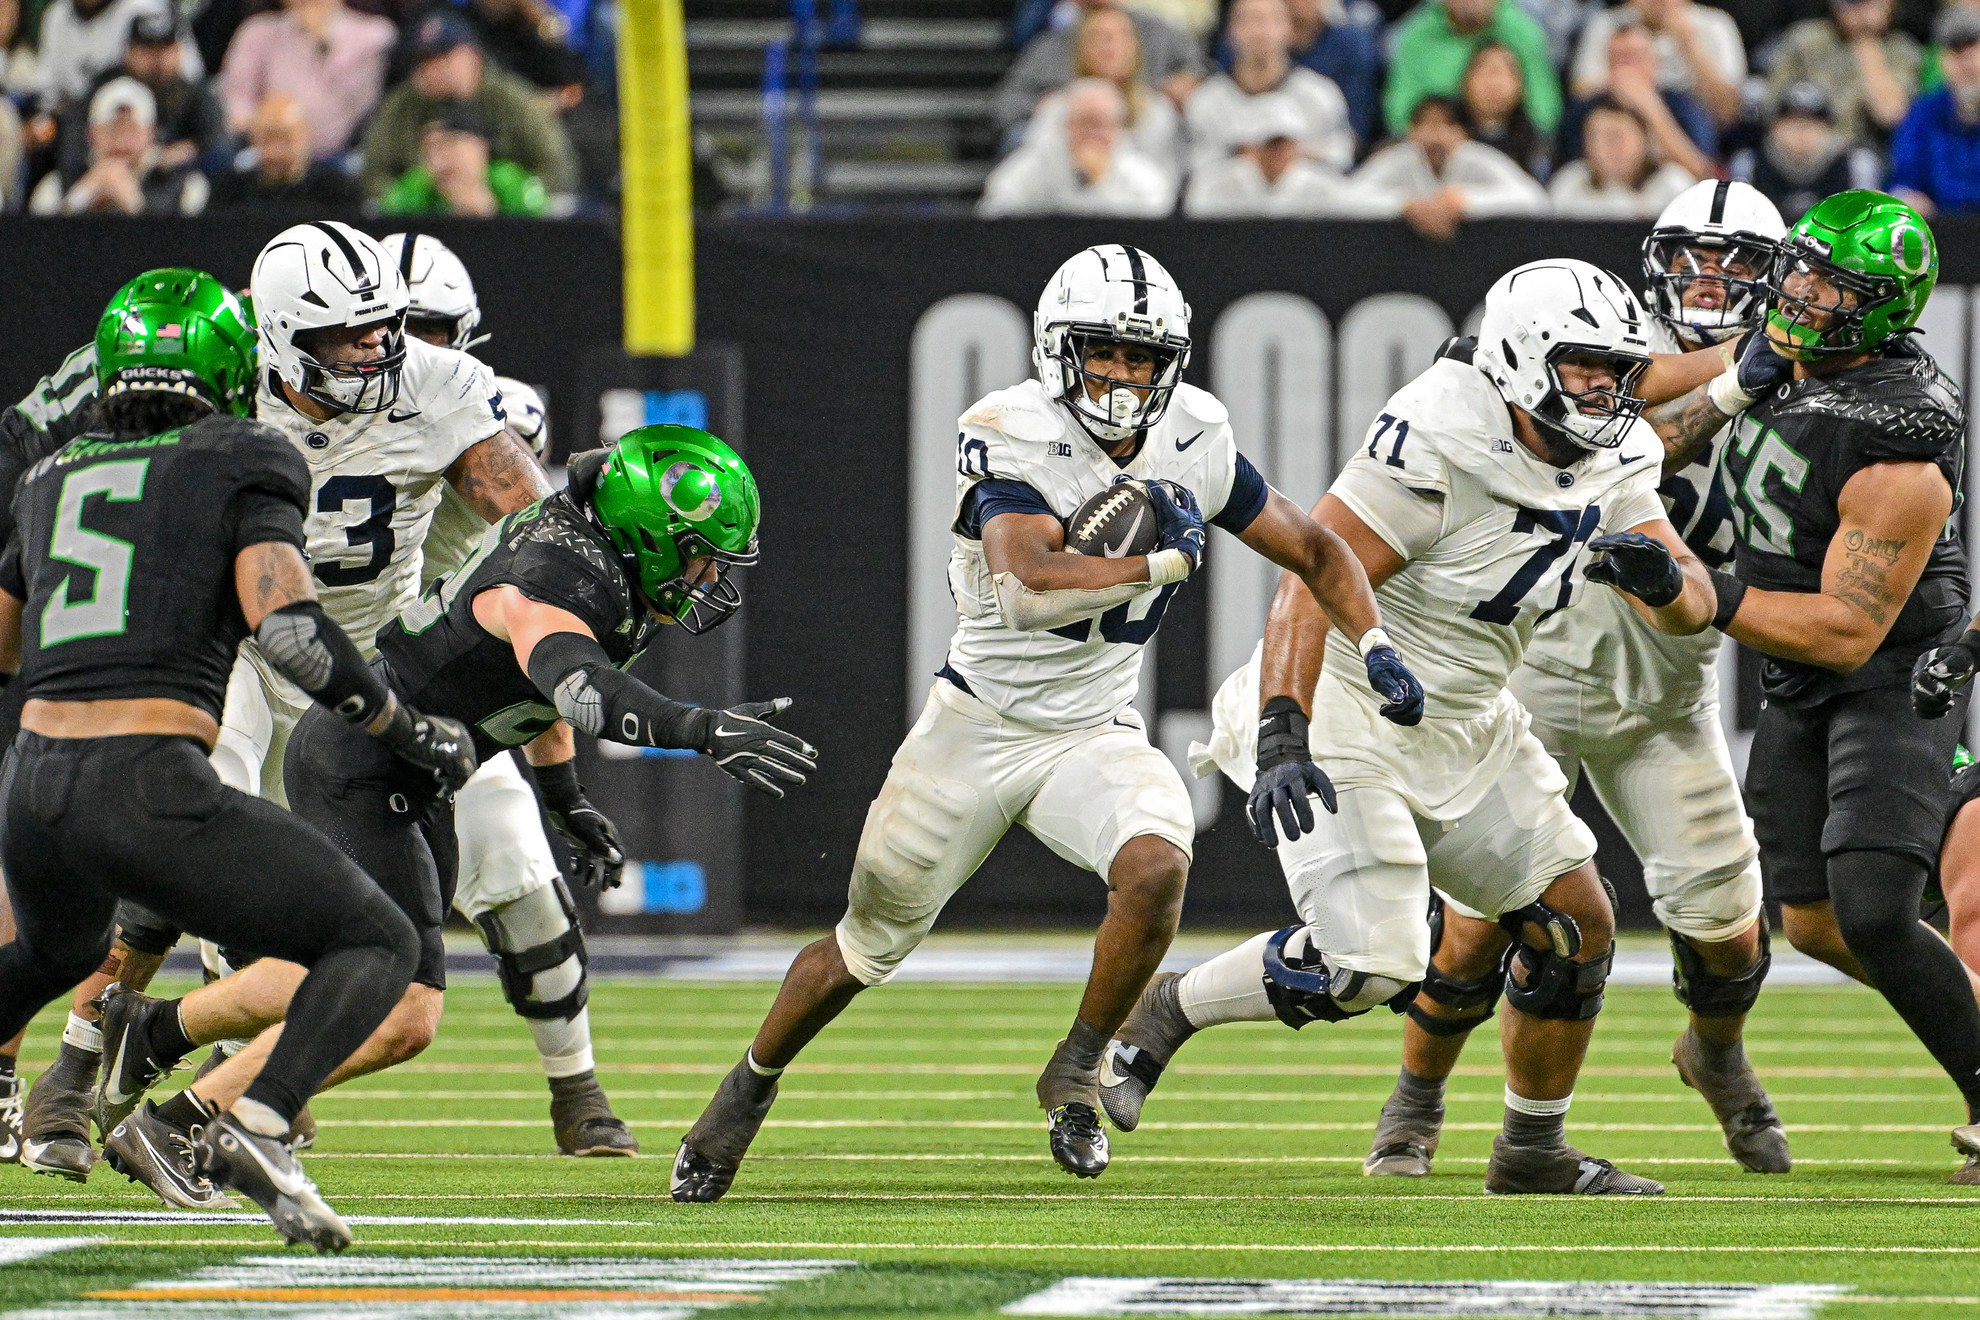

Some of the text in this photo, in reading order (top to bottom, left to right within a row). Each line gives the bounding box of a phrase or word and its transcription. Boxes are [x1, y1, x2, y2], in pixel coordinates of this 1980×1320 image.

[121, 367, 182, 380] DUCKS
[957, 431, 995, 480] 10
[1368, 412, 1409, 470] 71
[40, 457, 151, 650] 5
[1469, 503, 1601, 629] 71
